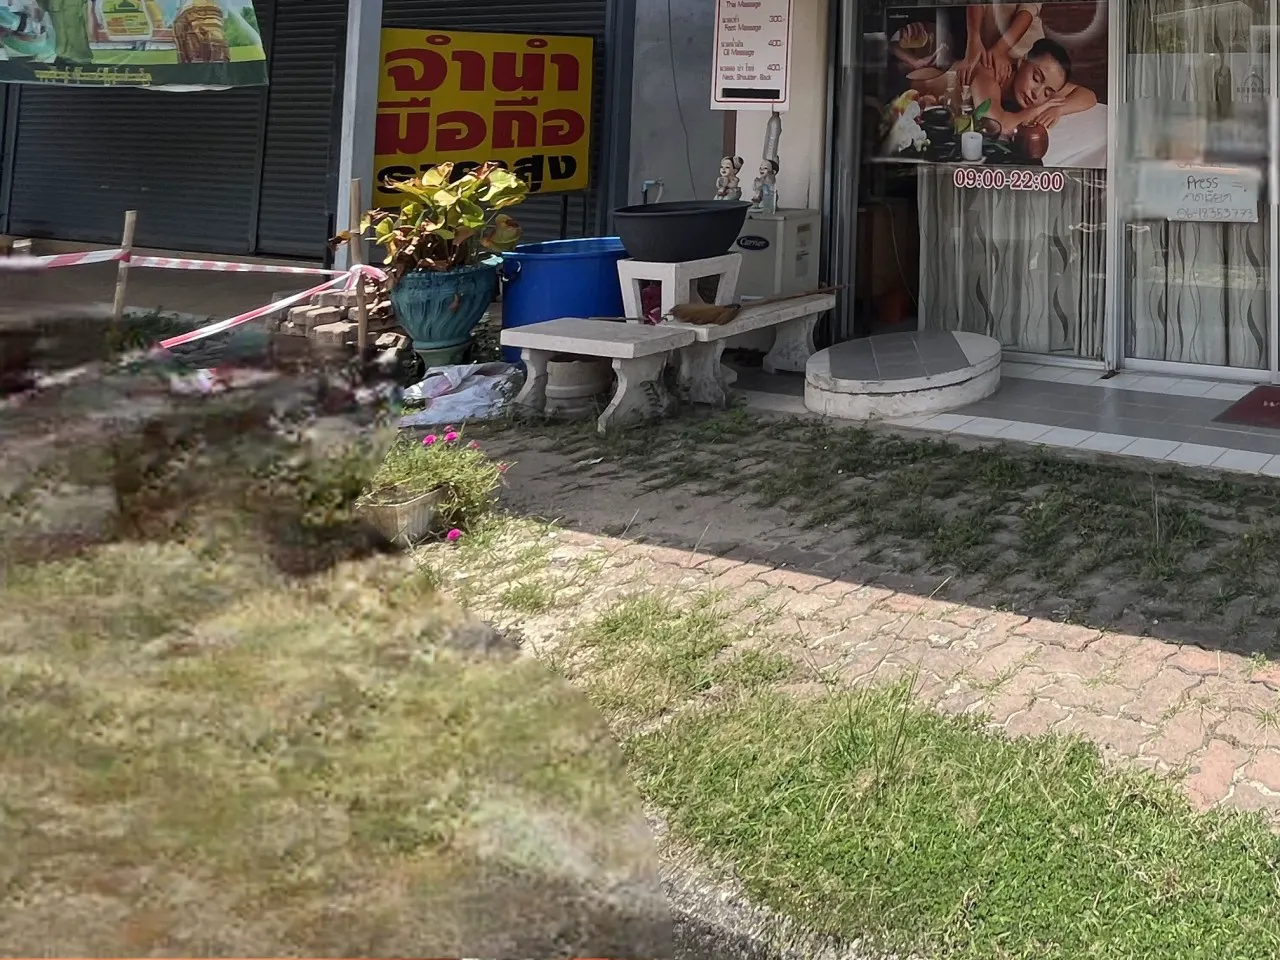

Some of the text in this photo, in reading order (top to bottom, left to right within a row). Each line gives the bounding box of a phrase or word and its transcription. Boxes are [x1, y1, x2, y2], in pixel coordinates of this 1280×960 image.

[385, 34, 580, 92] จำนำ
[375, 95, 586, 156] มือถือ
[954, 168, 1064, 192] 09:00-22:00
[1187, 175, 1219, 190] Press
[739, 236, 768, 247] Carrier
